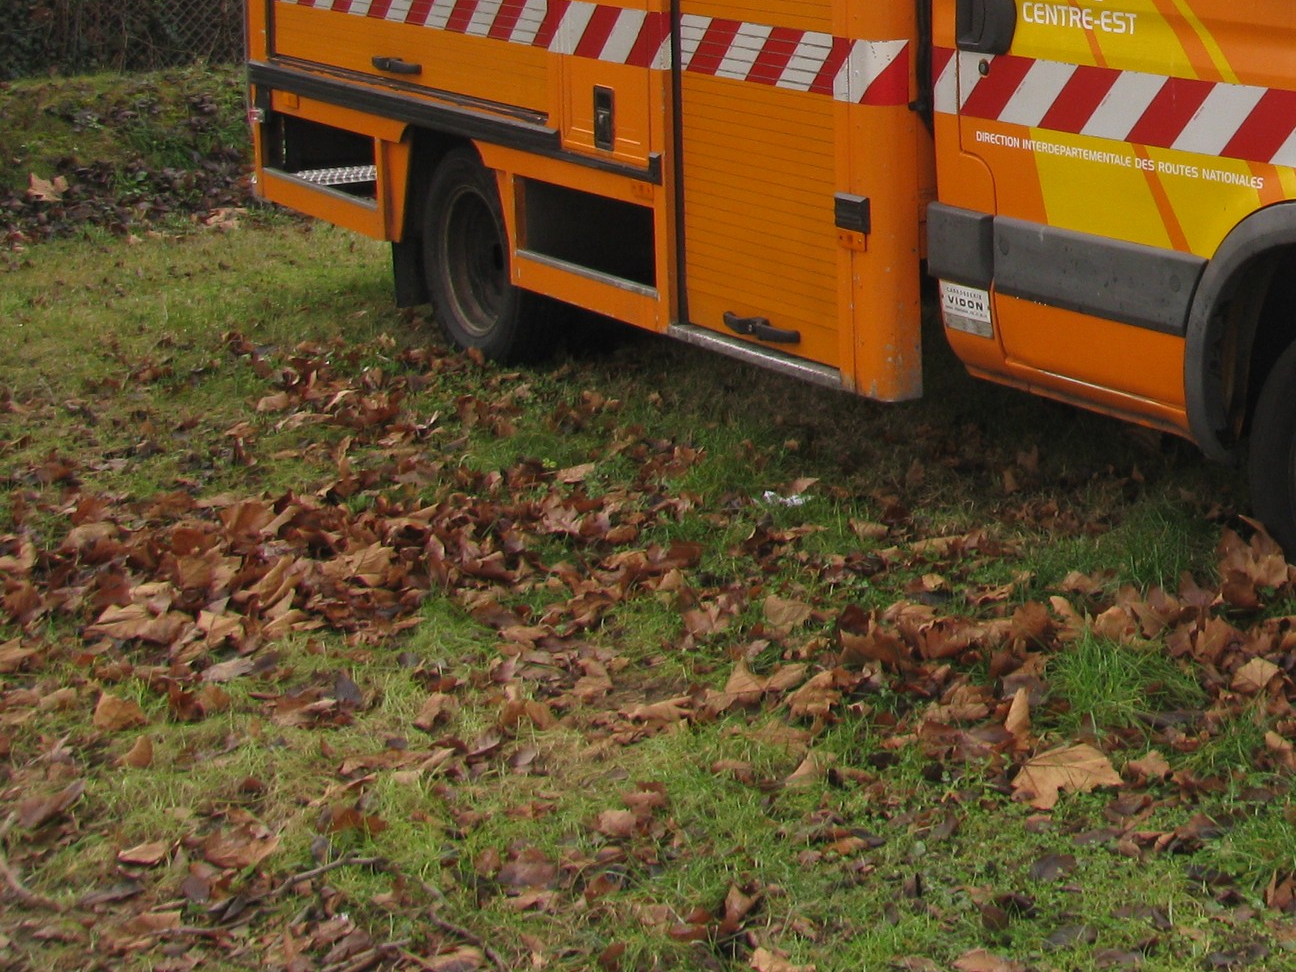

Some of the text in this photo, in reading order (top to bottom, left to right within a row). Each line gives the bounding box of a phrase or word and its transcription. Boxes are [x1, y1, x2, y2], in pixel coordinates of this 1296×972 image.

[1022, 2, 1137, 35] CENTRE-EST
[975, 130, 1264, 190] DIRECTION INTERDEPARTEMENTALE DES ROUTES NATIONALES
[947, 295, 983, 311] VIDON
